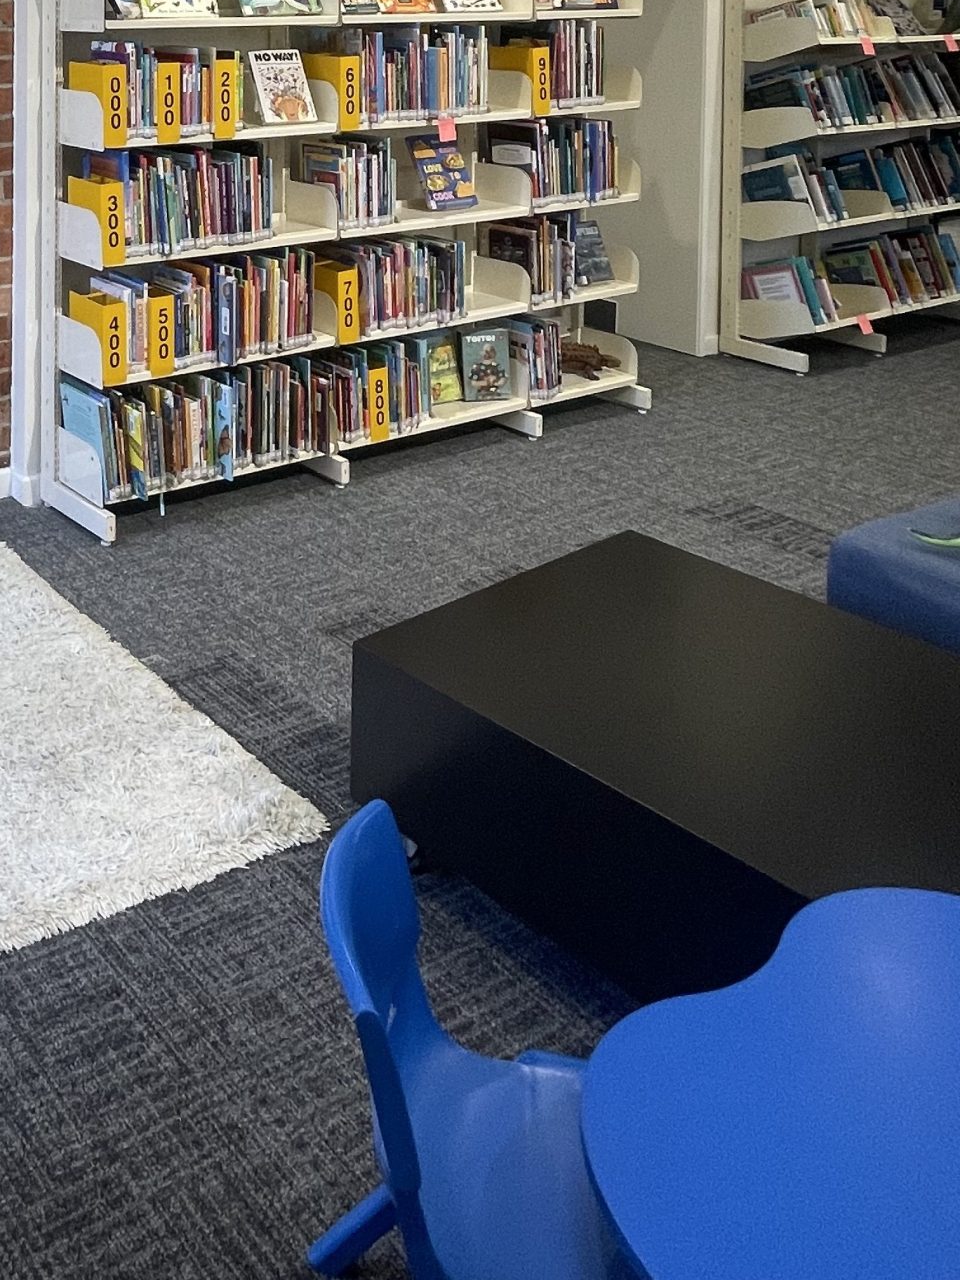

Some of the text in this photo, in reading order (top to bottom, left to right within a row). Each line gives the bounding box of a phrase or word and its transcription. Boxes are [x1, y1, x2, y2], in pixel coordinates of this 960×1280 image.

[254, 52, 299, 62] NO WAY!
[538, 57, 547, 101] 900
[110, 77, 122, 130] 000
[163, 74, 175, 126] 100
[220, 71, 231, 122] 200
[345, 67, 355, 116] 600
[423, 163, 443, 174] LOVE
[432, 191, 455, 201] COOK
[108, 195, 119, 248] 300
[343, 281, 353, 328] 700
[109, 316, 120, 368] 400
[158, 308, 169, 359] 500
[375, 379, 385, 426] 800
